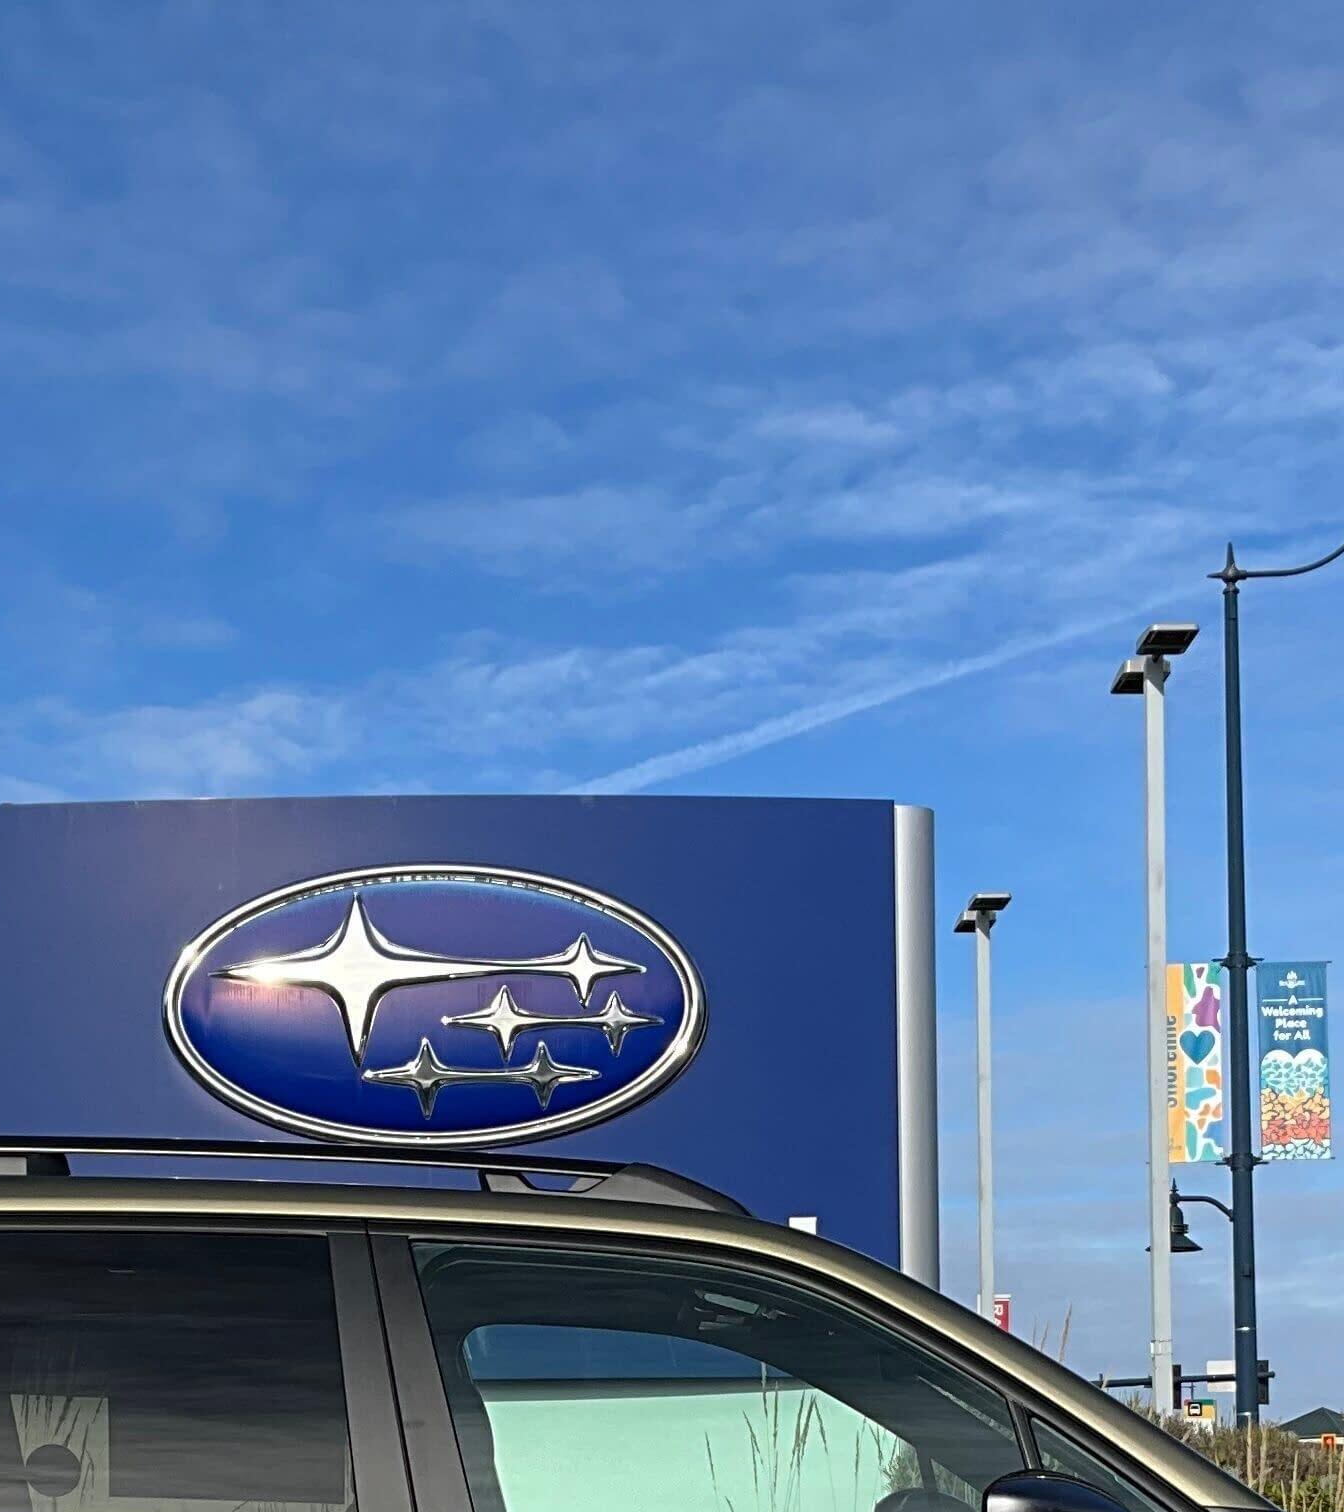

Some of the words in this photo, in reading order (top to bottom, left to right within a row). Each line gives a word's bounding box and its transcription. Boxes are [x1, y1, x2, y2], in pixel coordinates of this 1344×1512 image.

[1288, 994, 1298, 1005] A
[1261, 1005, 1324, 1018] Welcoming
[1275, 1018, 1307, 1028] Place
[1273, 1030, 1292, 1041] for
[1294, 1029, 1311, 1040] All
